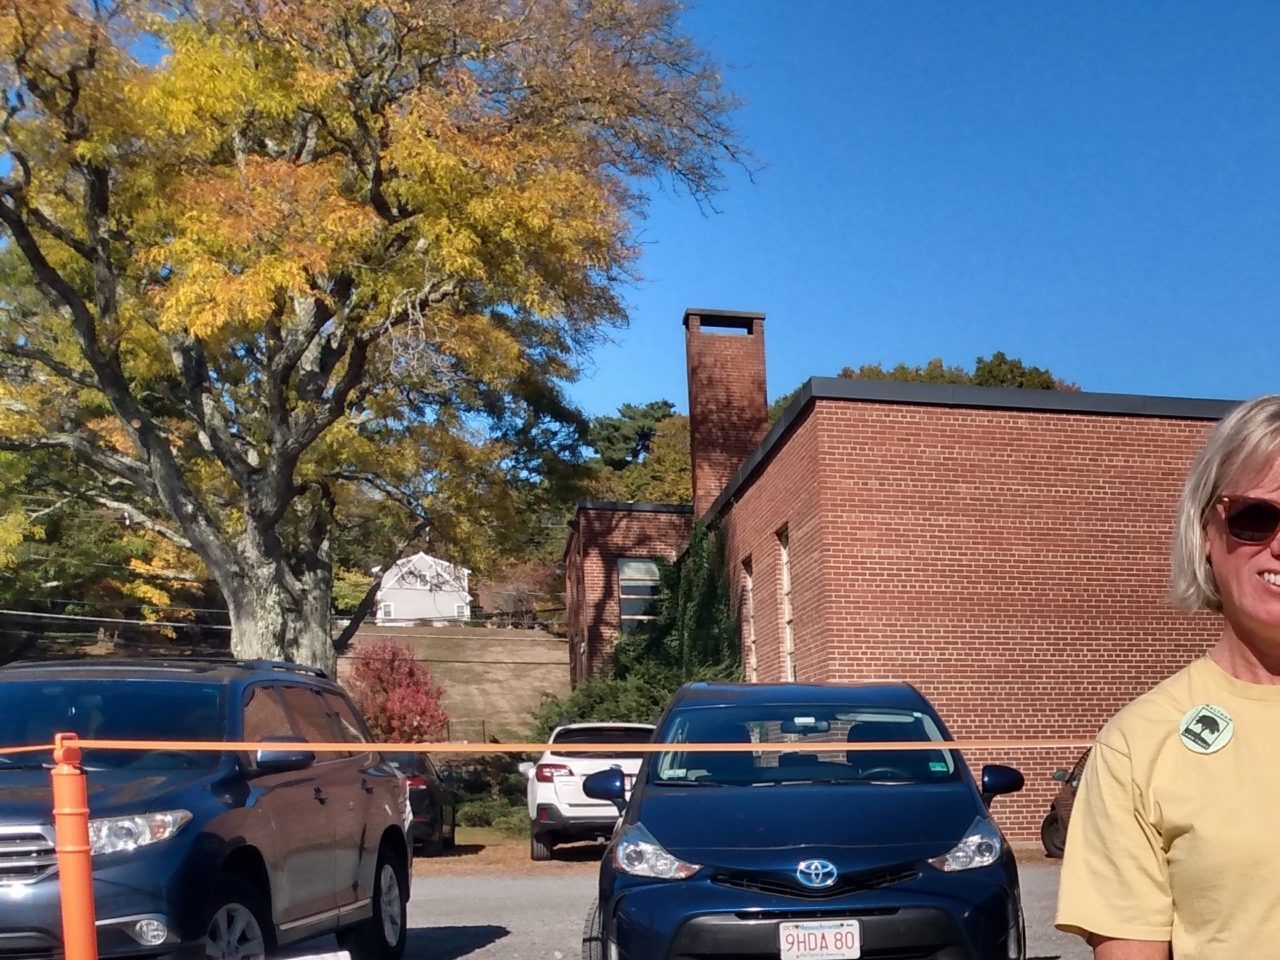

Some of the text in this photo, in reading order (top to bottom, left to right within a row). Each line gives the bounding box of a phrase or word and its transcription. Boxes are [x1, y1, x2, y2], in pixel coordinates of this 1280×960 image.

[1205, 704, 1232, 722] WALTHAM
[786, 931, 854, 951] 9HDA 80
